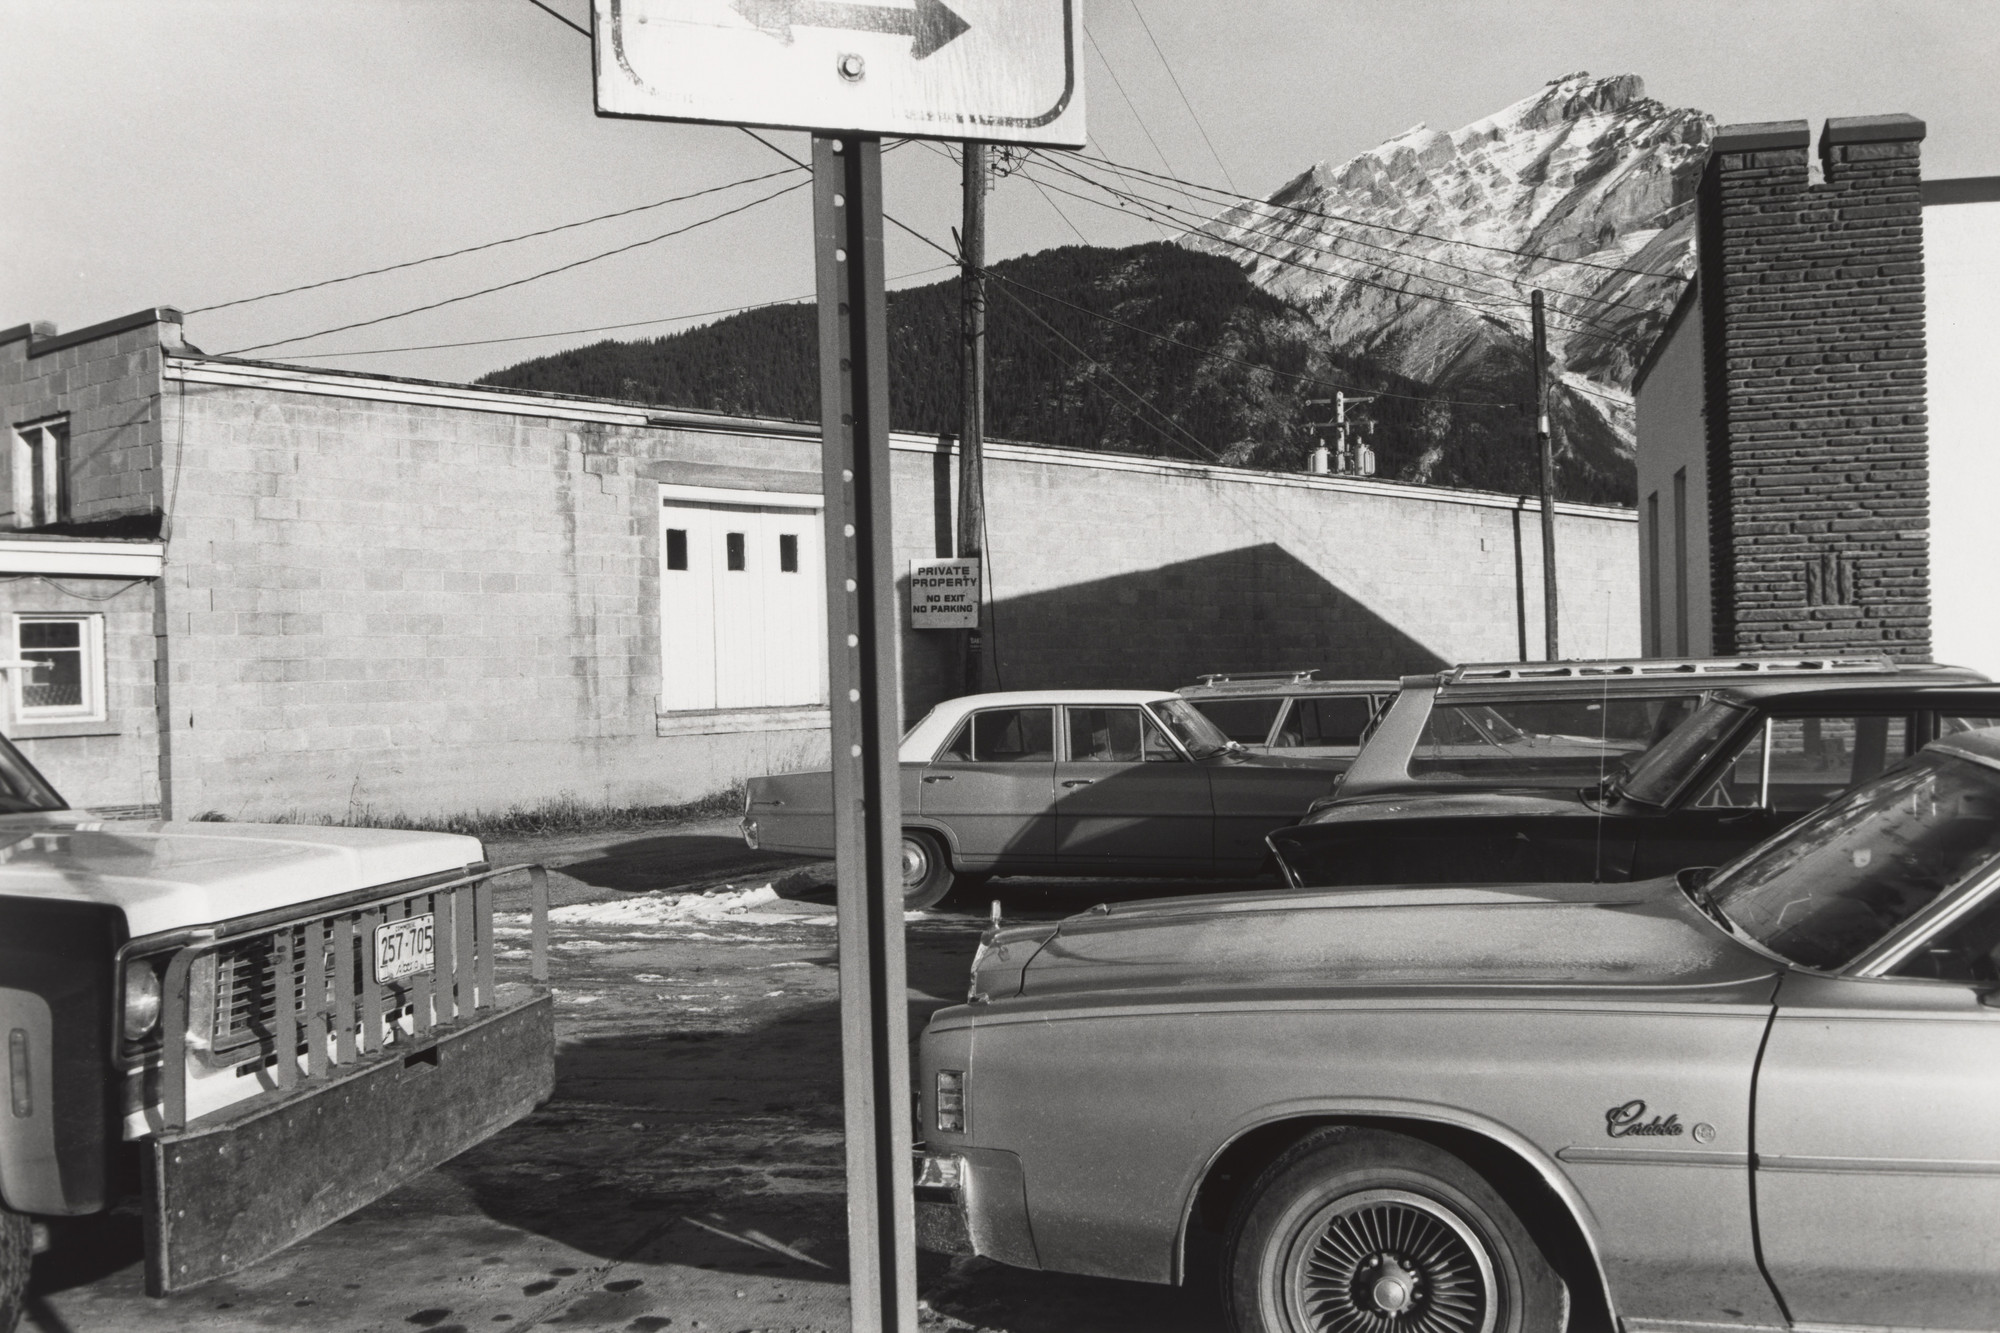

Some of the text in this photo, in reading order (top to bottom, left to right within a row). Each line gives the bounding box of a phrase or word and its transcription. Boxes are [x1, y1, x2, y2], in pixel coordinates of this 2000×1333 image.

[917, 566, 970, 575] PRIVATE
[912, 578, 977, 587] PROPERTY
[926, 594, 965, 602] NO EXIT
[913, 605, 973, 613] NO PARKING
[1605, 1099, 1684, 1138] Cordoba
